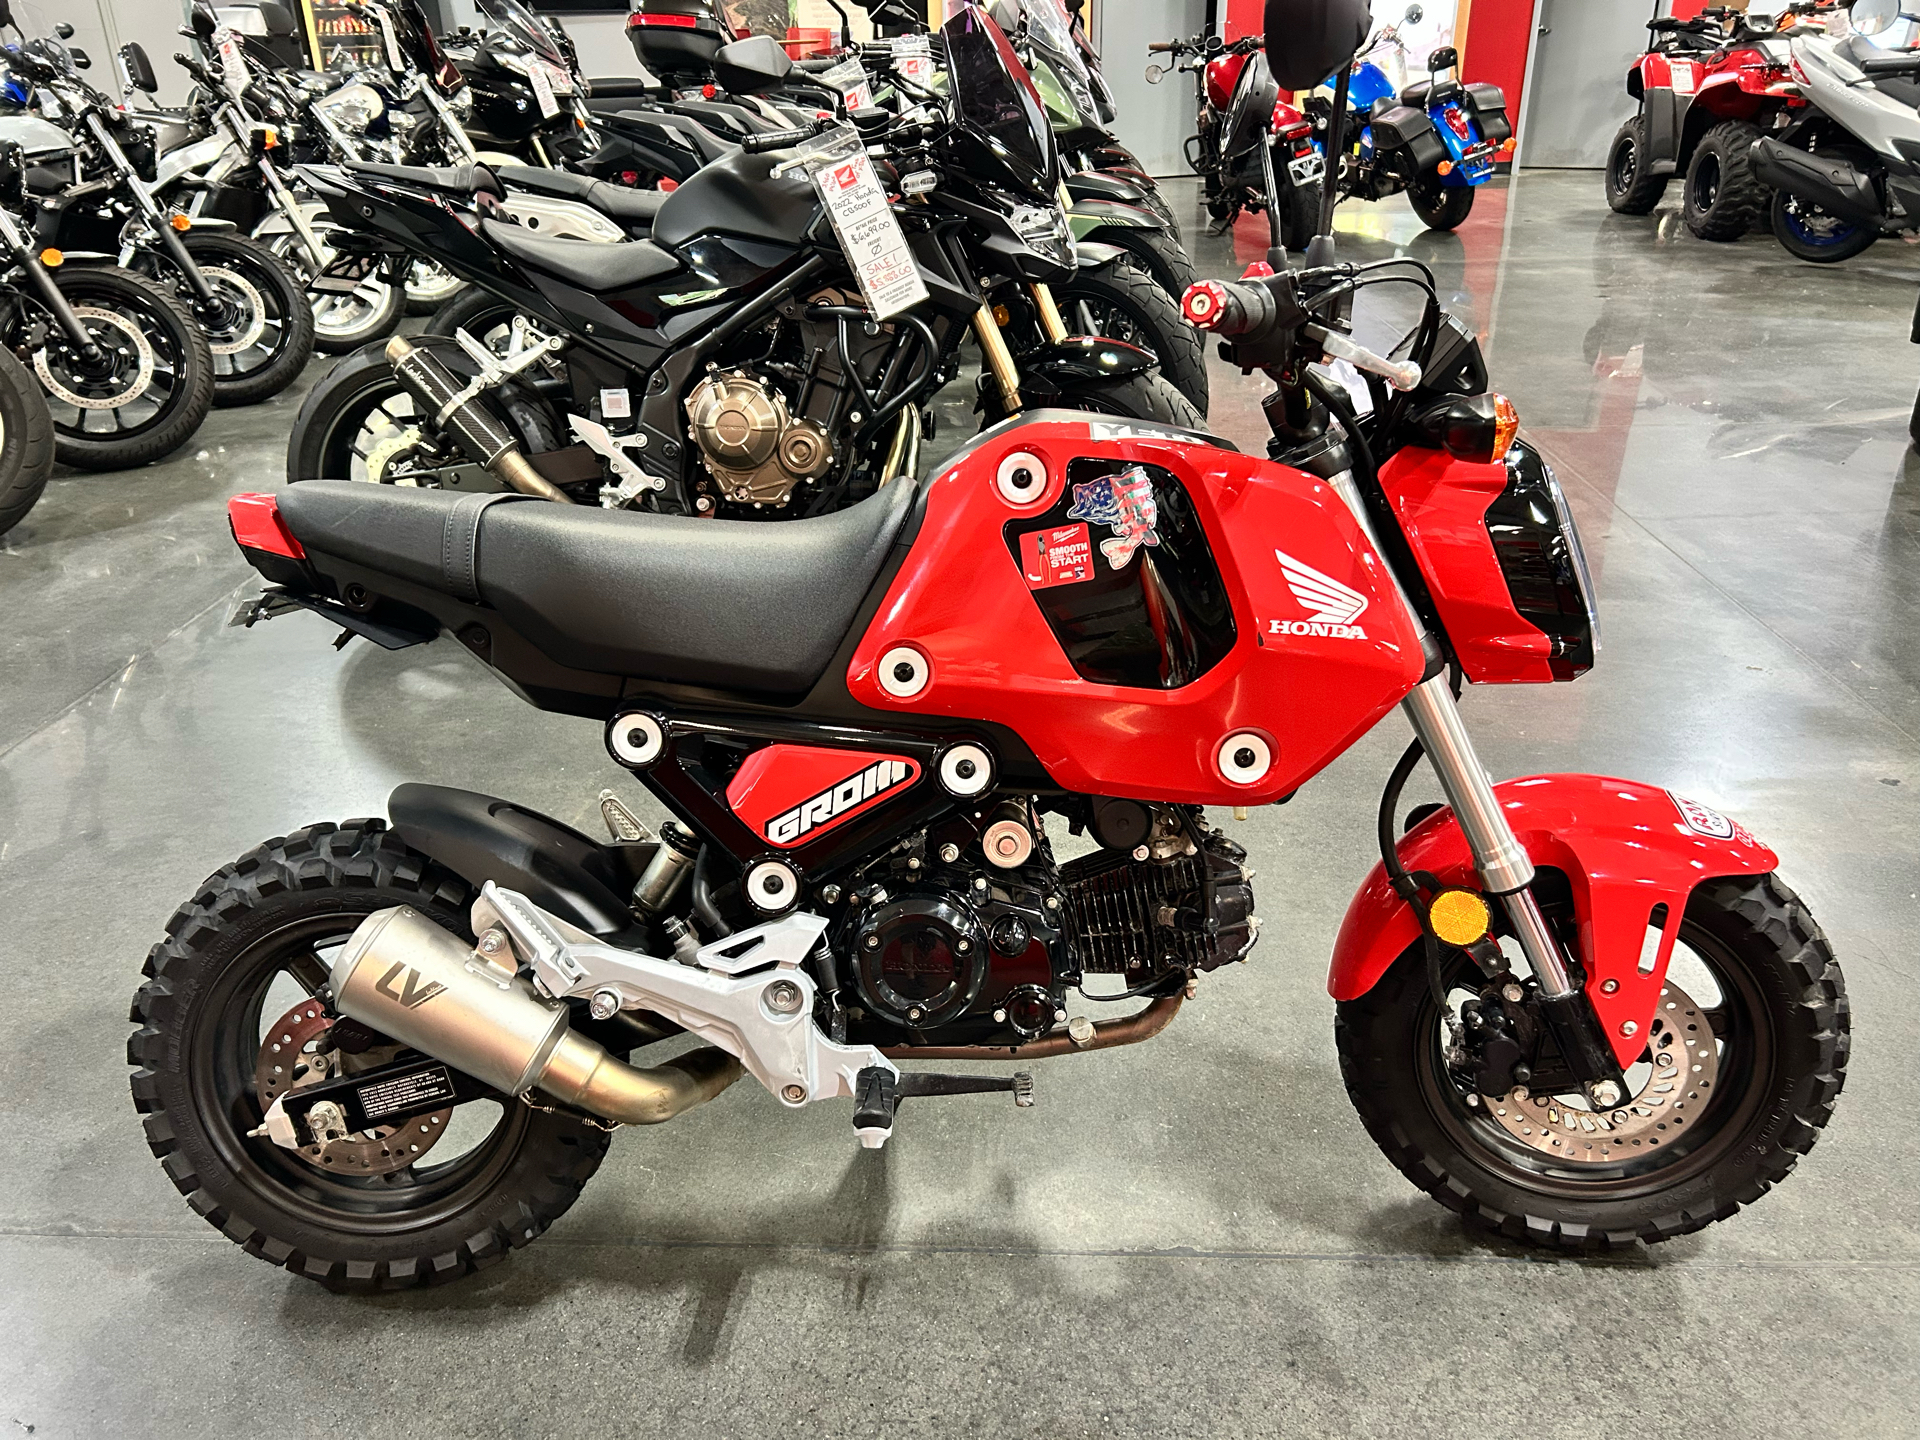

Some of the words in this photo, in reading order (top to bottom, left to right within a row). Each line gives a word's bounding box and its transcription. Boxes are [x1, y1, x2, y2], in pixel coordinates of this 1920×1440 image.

[832, 198, 852, 210] 2022
[854, 187, 880, 201] Honda
[842, 198, 872, 216] CB500F
[1049, 542, 1088, 555] SMOOTH
[1050, 554, 1089, 568] START
[1268, 620, 1368, 639] HONDA
[768, 760, 906, 844] GROM
